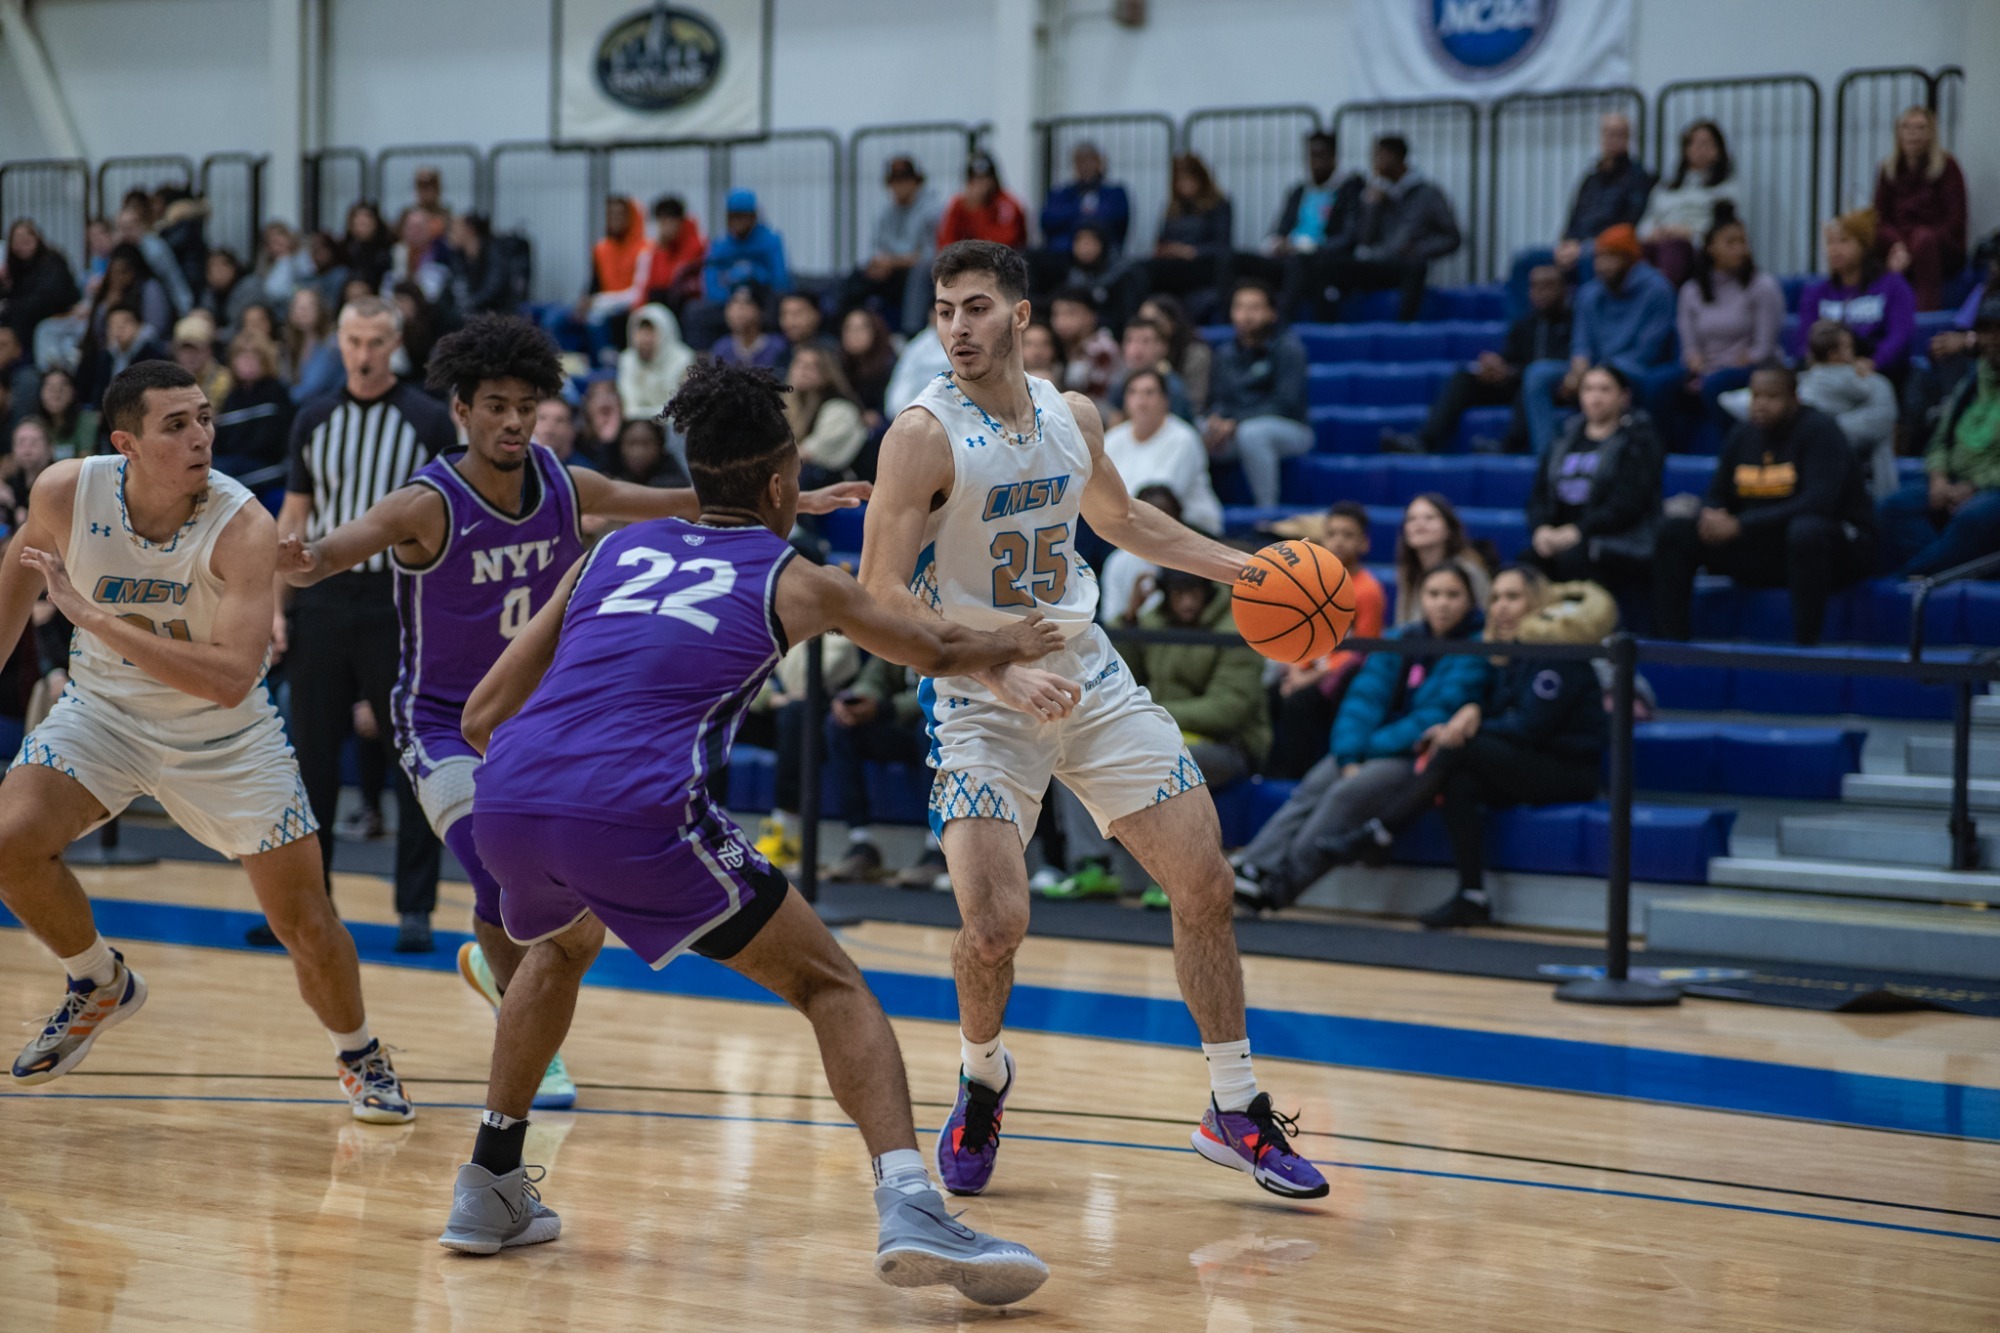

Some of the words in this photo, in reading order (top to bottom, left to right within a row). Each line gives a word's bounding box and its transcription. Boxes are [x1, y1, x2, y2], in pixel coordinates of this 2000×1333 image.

[982, 475, 1070, 522] CMSV
[92, 575, 193, 606] CMSV
[596, 546, 739, 635] 22
[990, 522, 1069, 608] 25
[499, 586, 532, 640] 0
